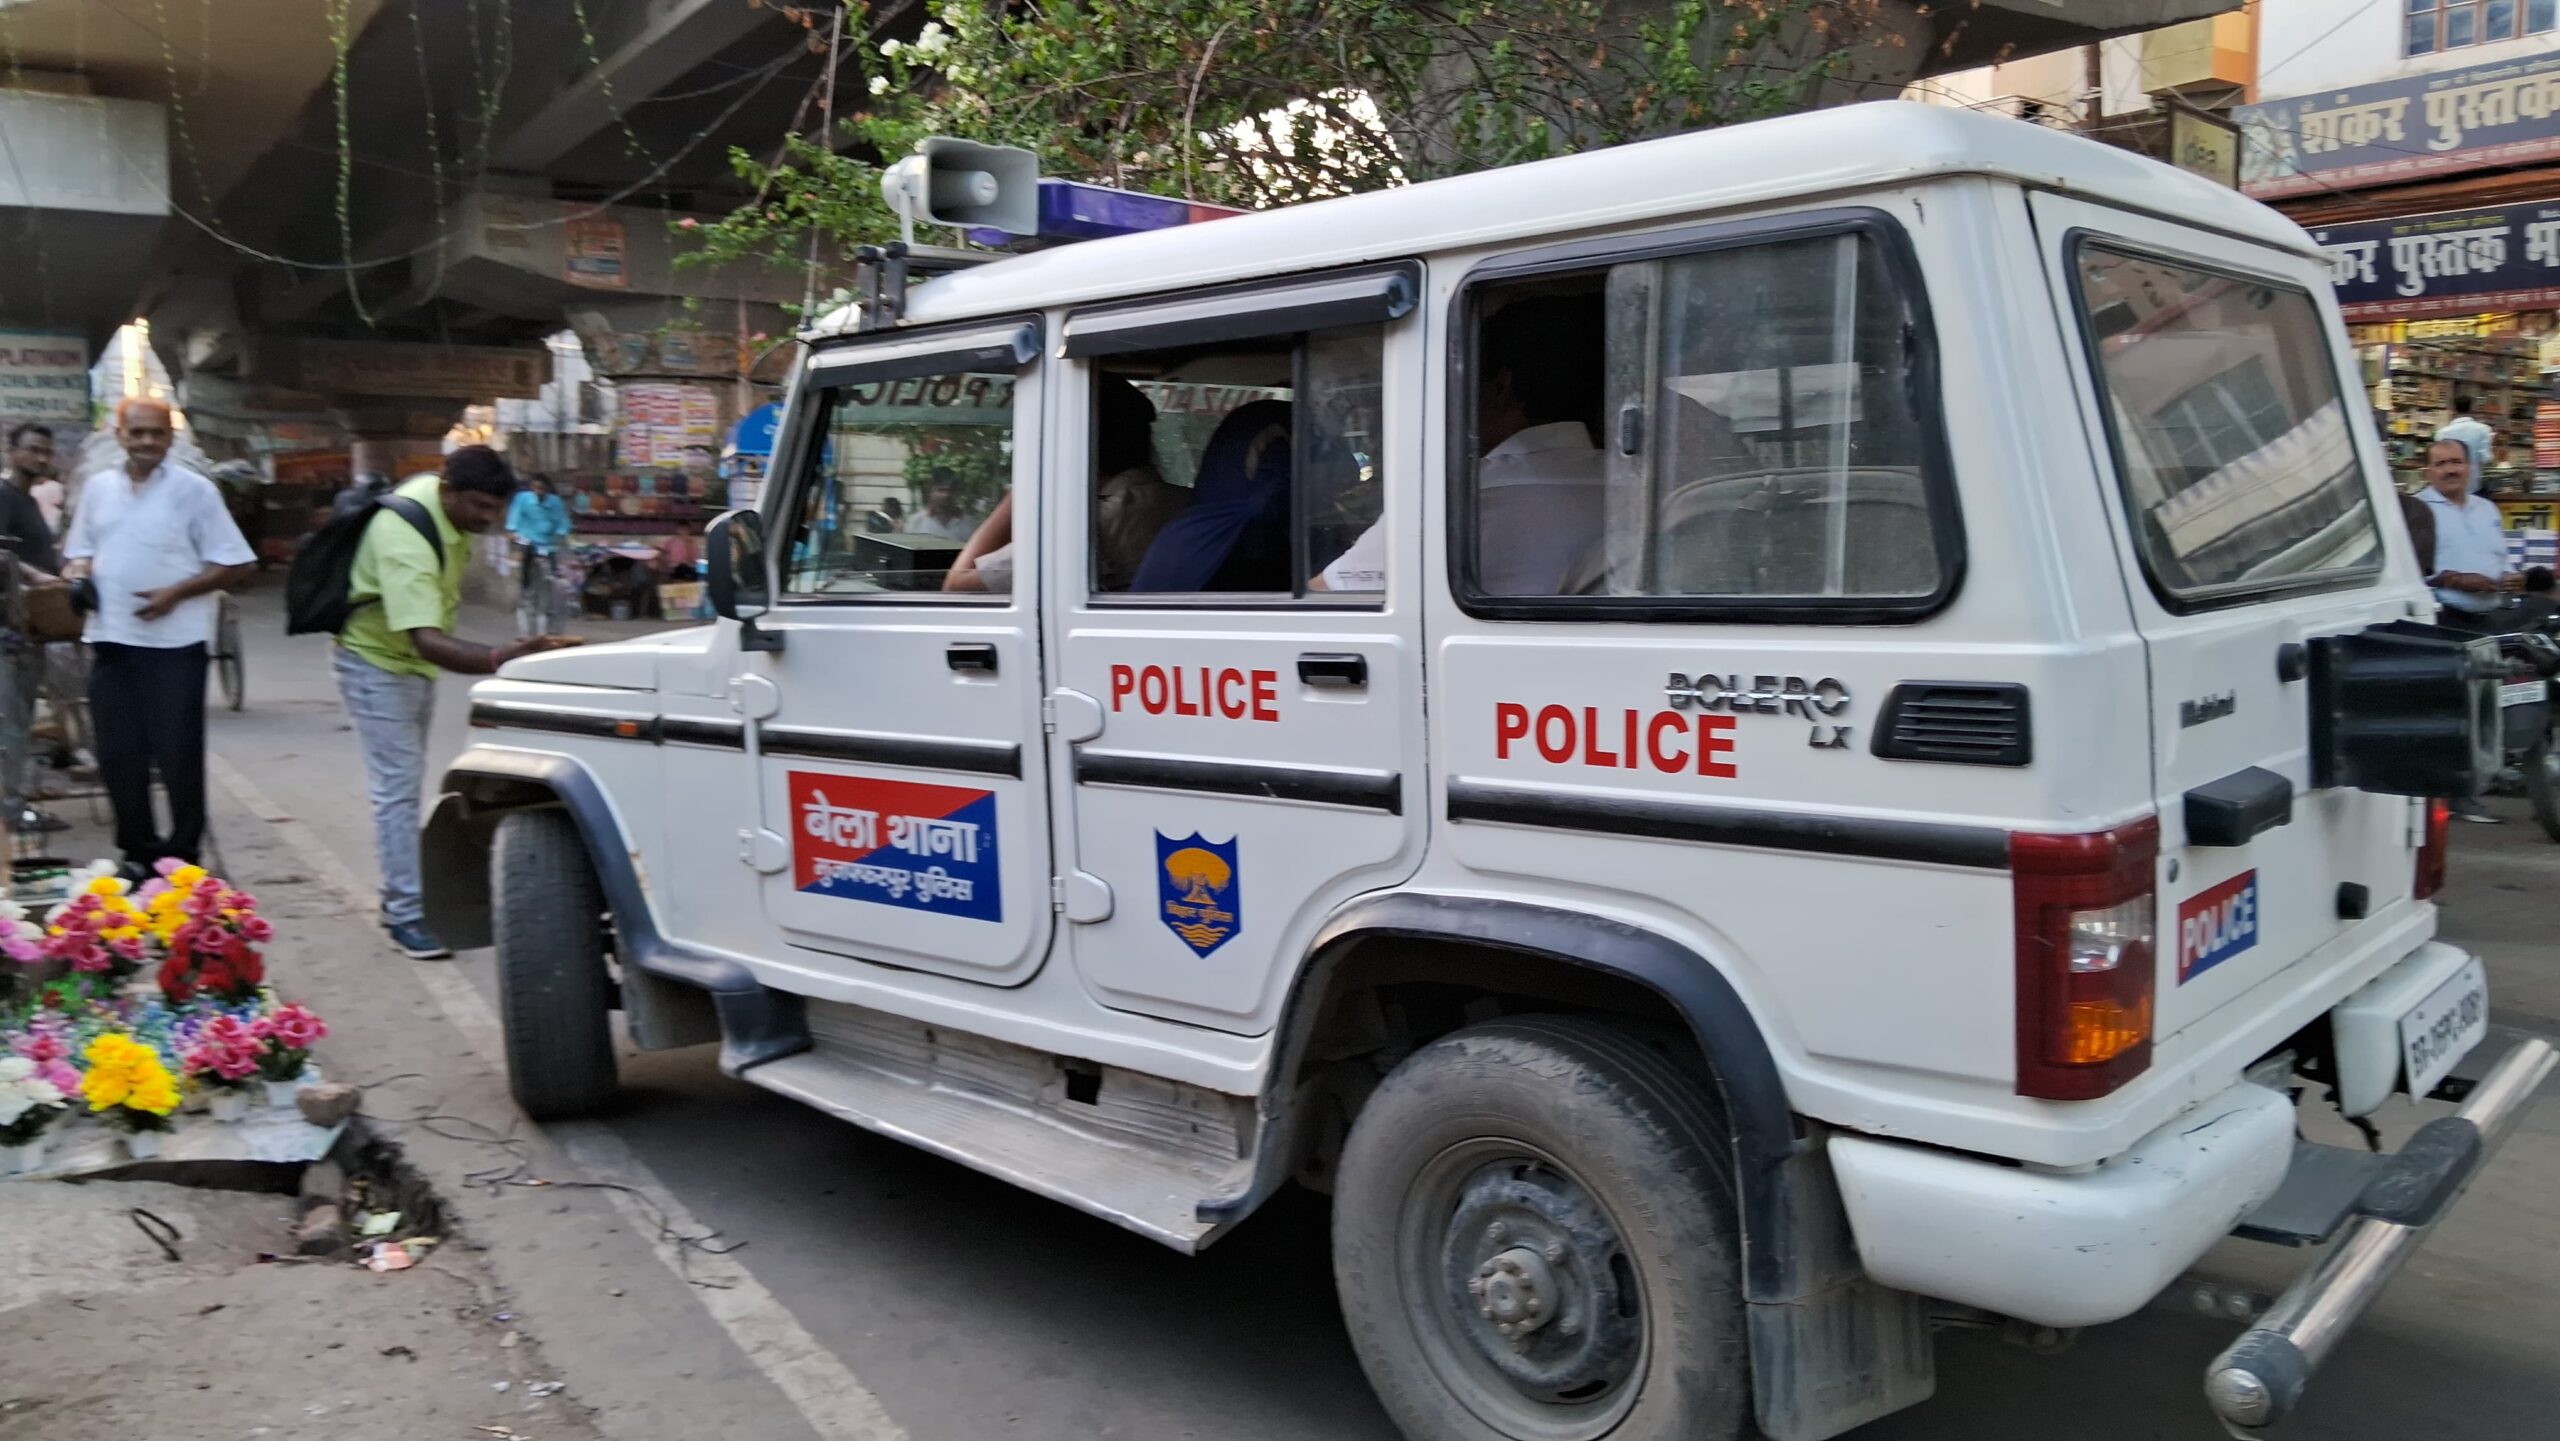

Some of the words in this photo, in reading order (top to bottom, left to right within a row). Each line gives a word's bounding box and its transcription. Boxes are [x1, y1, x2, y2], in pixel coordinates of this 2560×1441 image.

[2299, 93, 2410, 154] शंकर
[2388, 226, 2511, 297] पुस्तक
[1110, 664, 1281, 723] POLICE
[1664, 672, 1852, 721] BOLERO
[1496, 702, 1737, 778] POLICE
[1809, 725, 1853, 749] LX
[802, 788, 879, 850] बेला
[886, 815, 980, 864] थाना
[913, 865, 975, 903] पुलिस
[2181, 886, 2256, 969] POLICE
